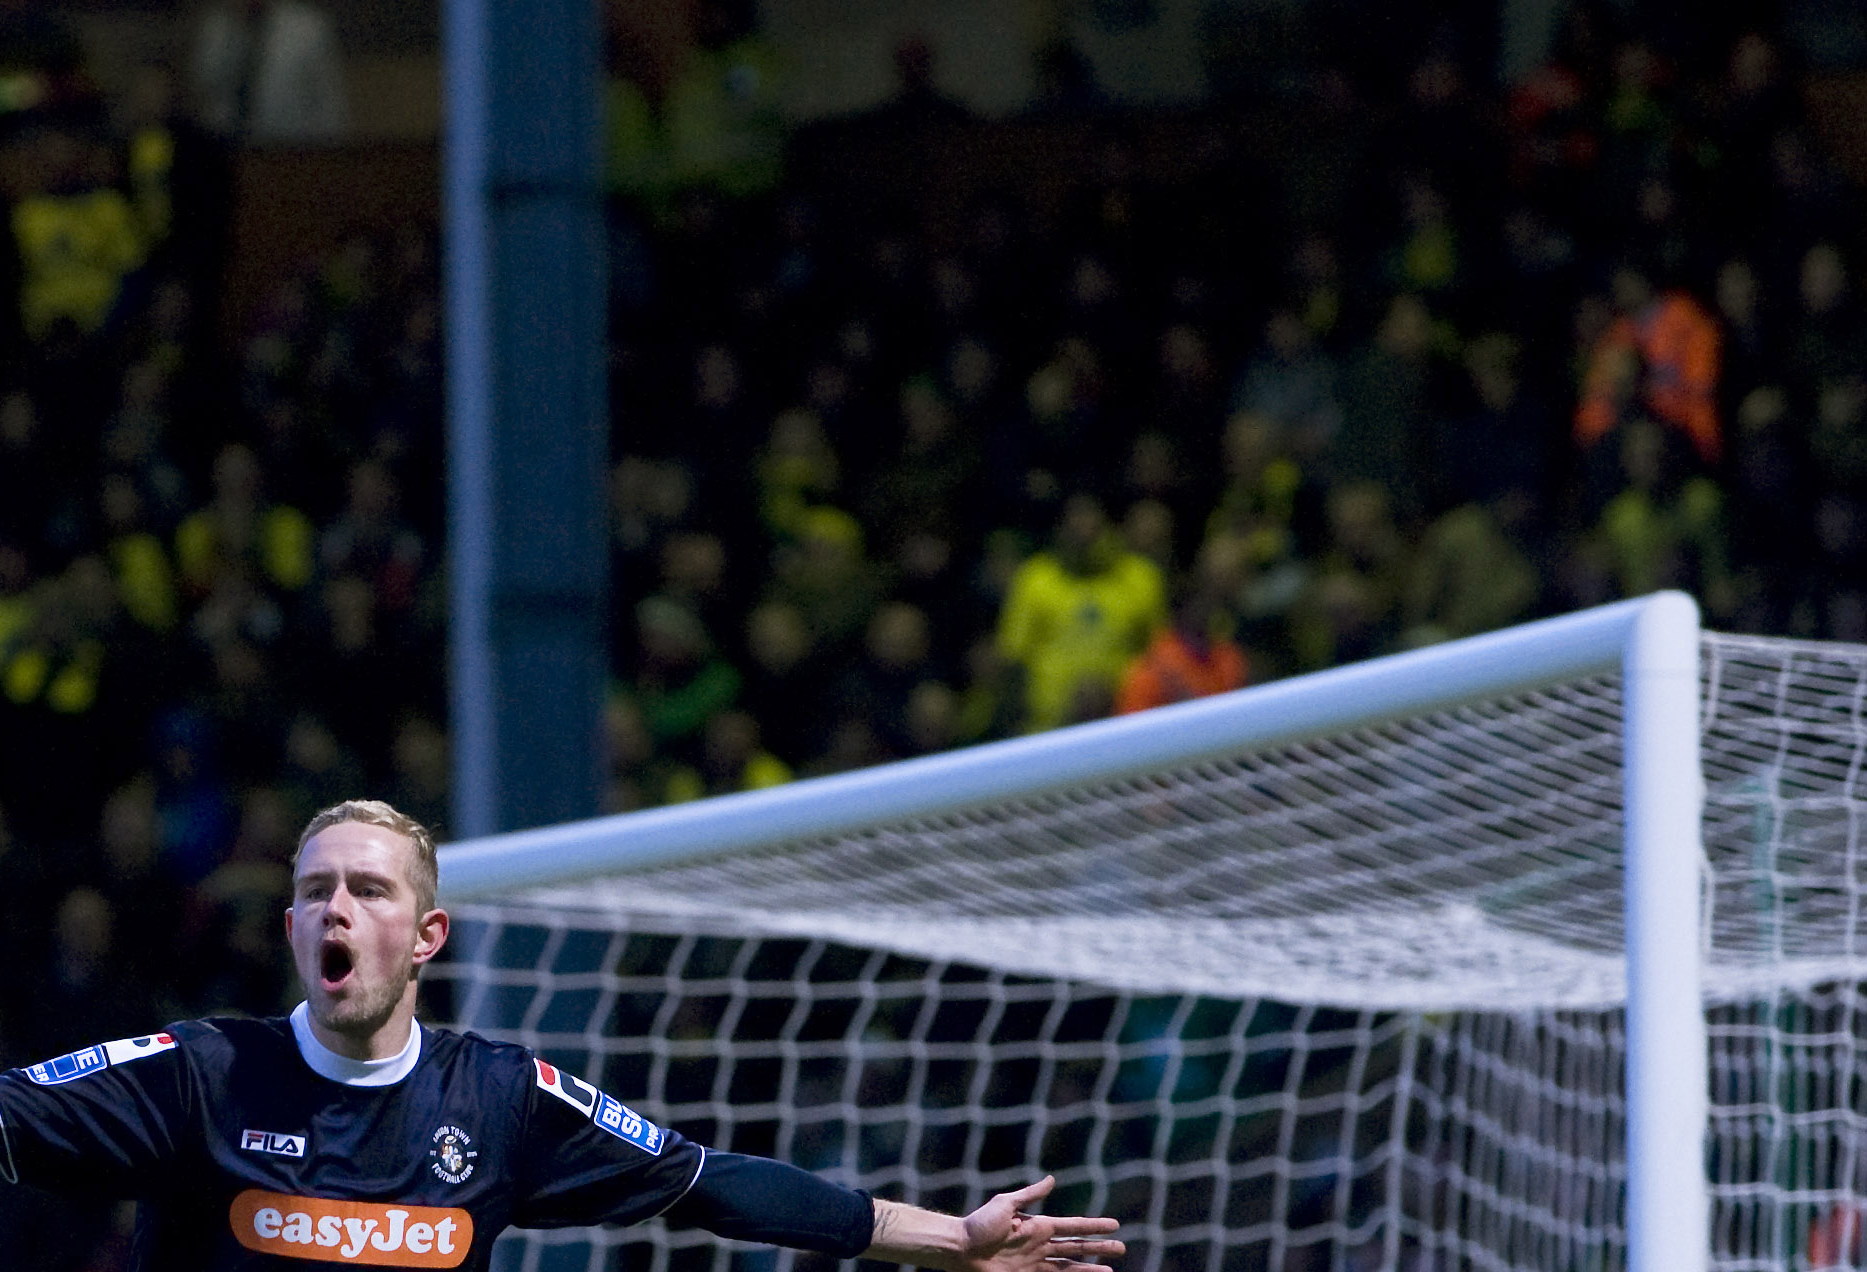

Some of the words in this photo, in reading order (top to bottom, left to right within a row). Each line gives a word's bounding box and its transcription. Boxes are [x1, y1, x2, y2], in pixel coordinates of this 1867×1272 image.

[246, 1133, 299, 1153] FILA
[451, 1126, 471, 1146] TOWN
[253, 1207, 457, 1259] easyJet
